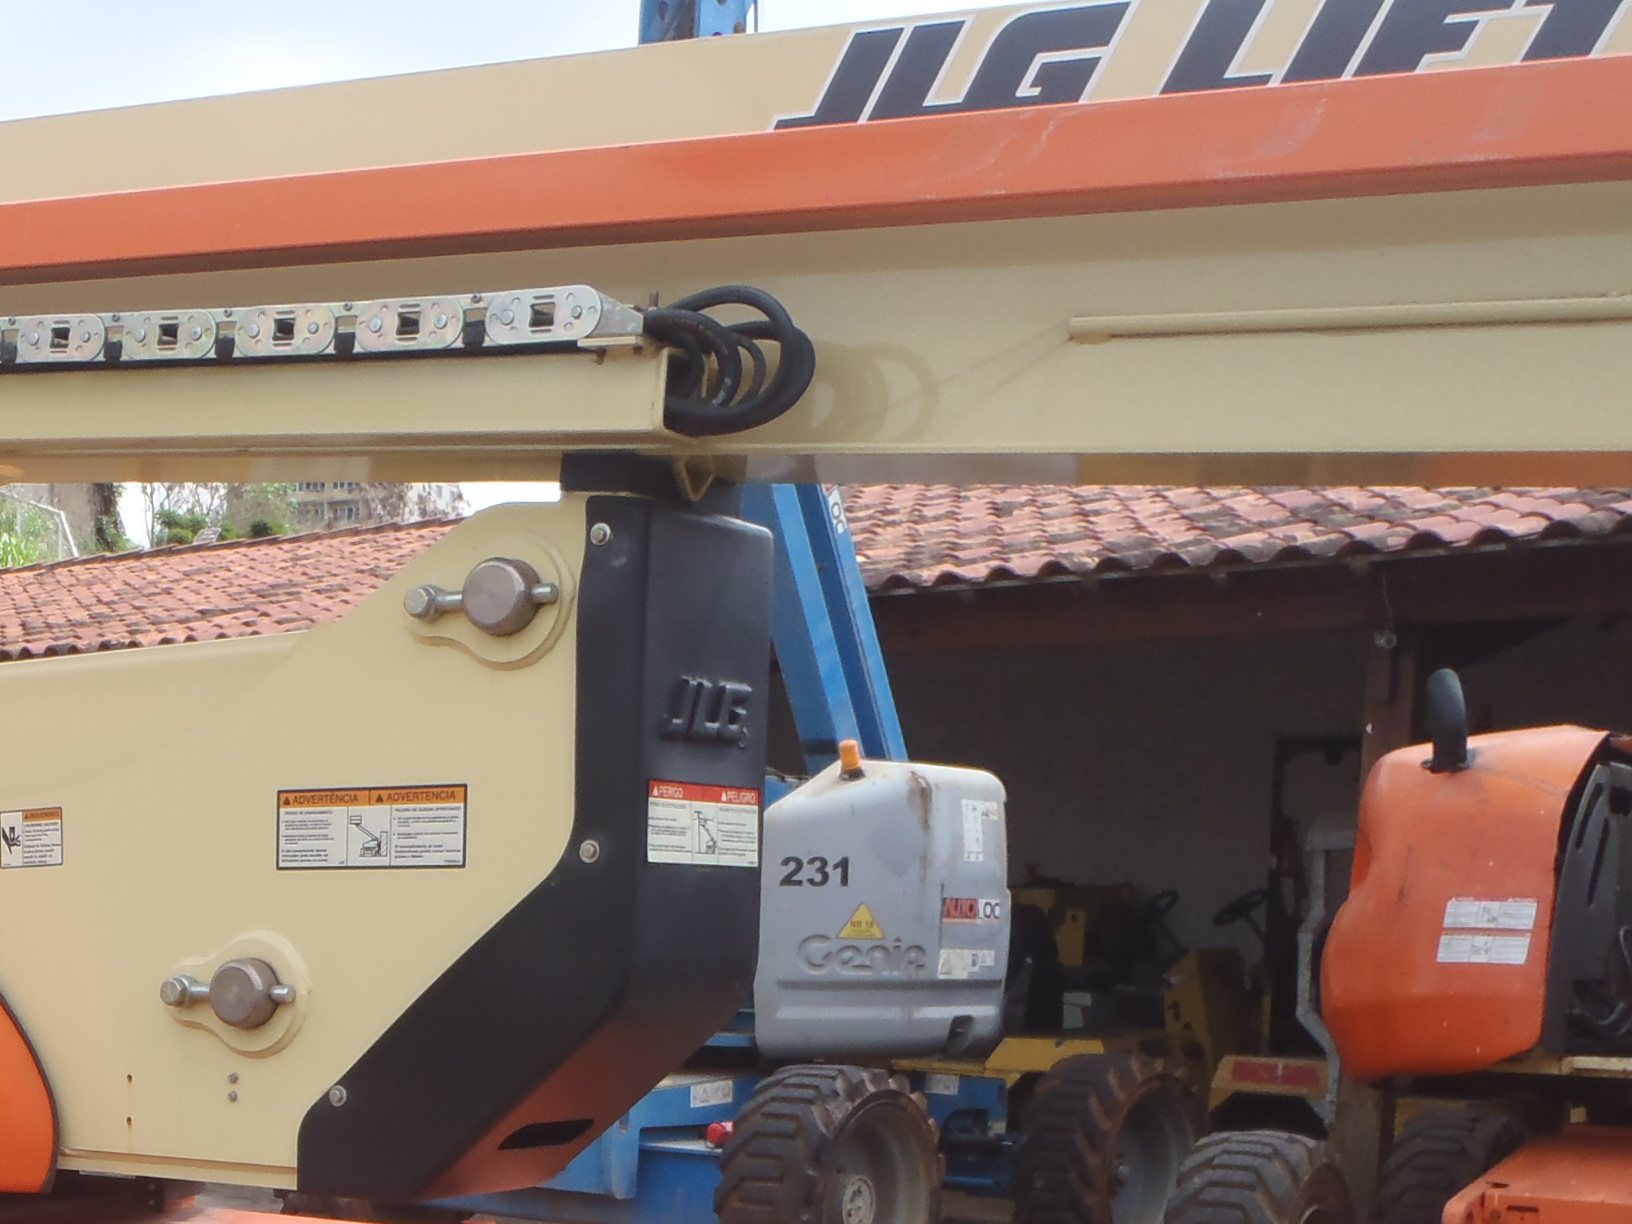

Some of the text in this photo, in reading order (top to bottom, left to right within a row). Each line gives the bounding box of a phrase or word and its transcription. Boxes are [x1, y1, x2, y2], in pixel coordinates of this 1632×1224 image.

[772, 1, 1132, 131] JLG
[662, 675, 753, 740] JLG
[292, 790, 457, 806] ADVERTÊNCIA ADVERTENCIA
[658, 785, 756, 804] PERIGO PELIGRO
[779, 856, 850, 887] 231
[797, 933, 928, 976] Genie
